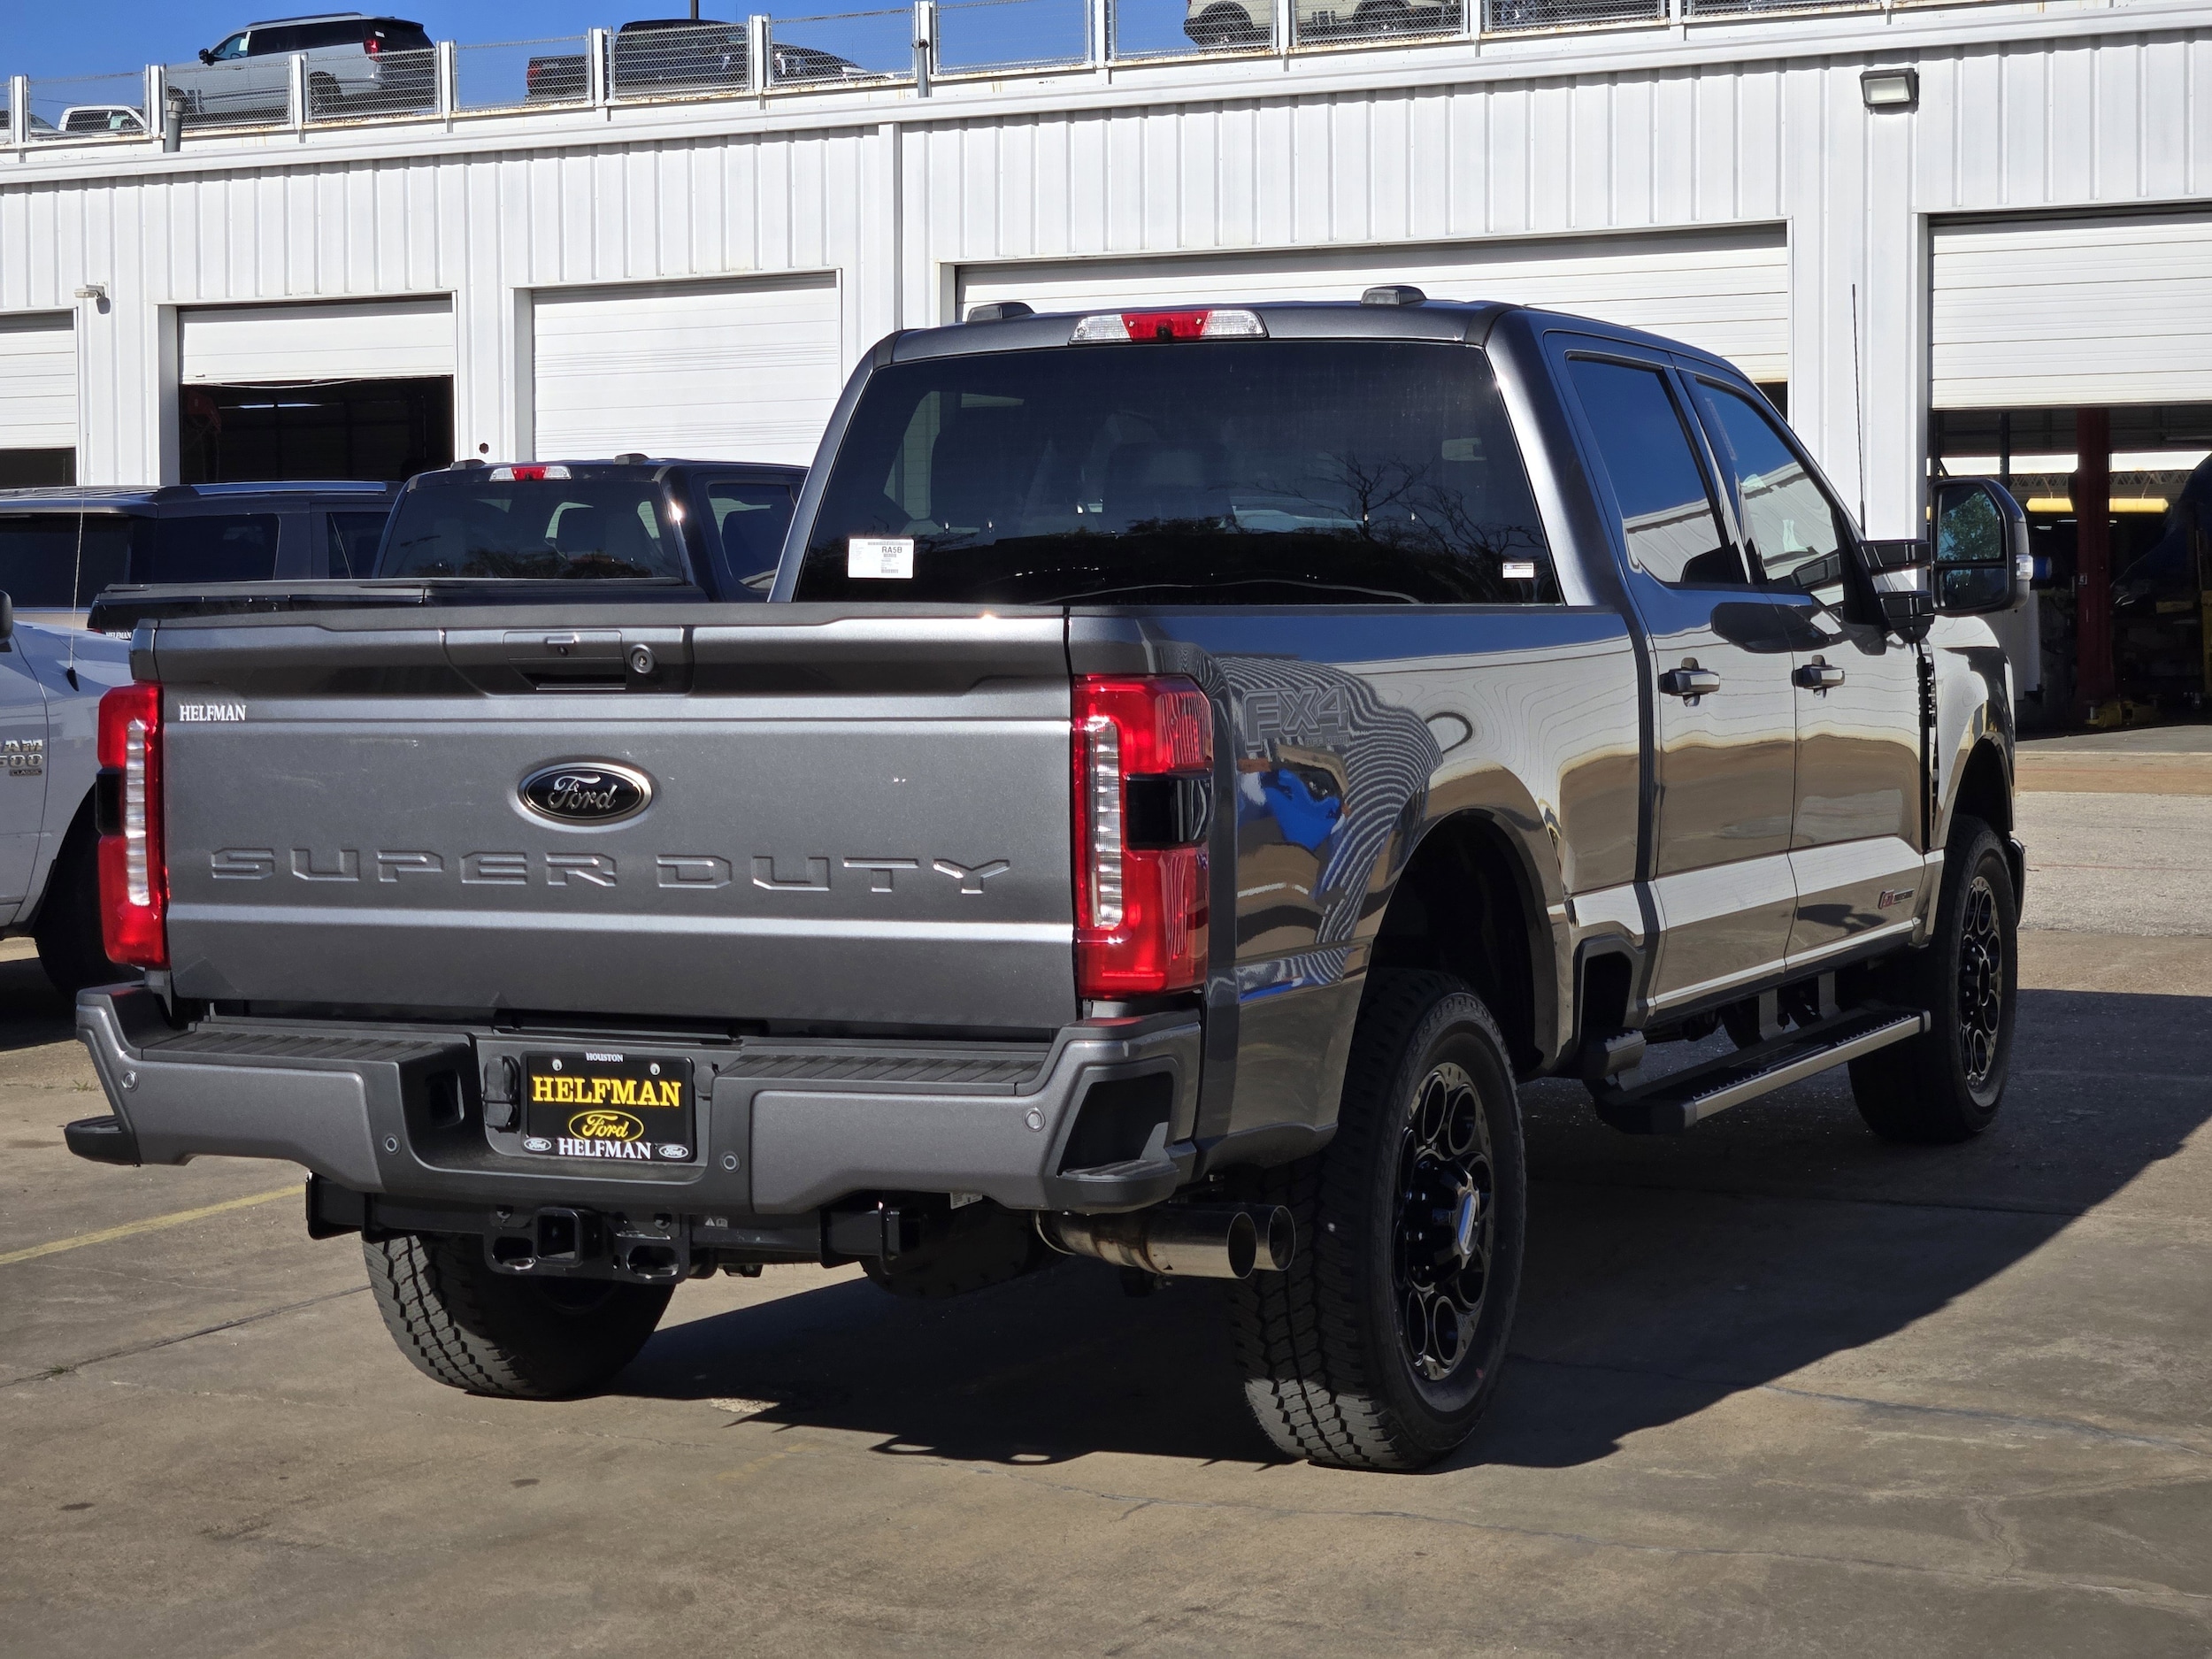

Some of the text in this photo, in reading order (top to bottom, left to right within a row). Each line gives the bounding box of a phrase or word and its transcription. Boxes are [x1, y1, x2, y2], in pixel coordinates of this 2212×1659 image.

[179, 704, 247, 721] HELFMAN
[1242, 685, 1350, 752] FX4
[0, 739, 43, 752] AM
[547, 775, 618, 810] Ford
[211, 848, 1010, 895] SUPER DUTY
[585, 1052, 624, 1063] HOUSTON
[532, 1076, 682, 1107] HELFMAN
[582, 1114, 630, 1138] Ford
[557, 1137, 652, 1160] HELFMAN
